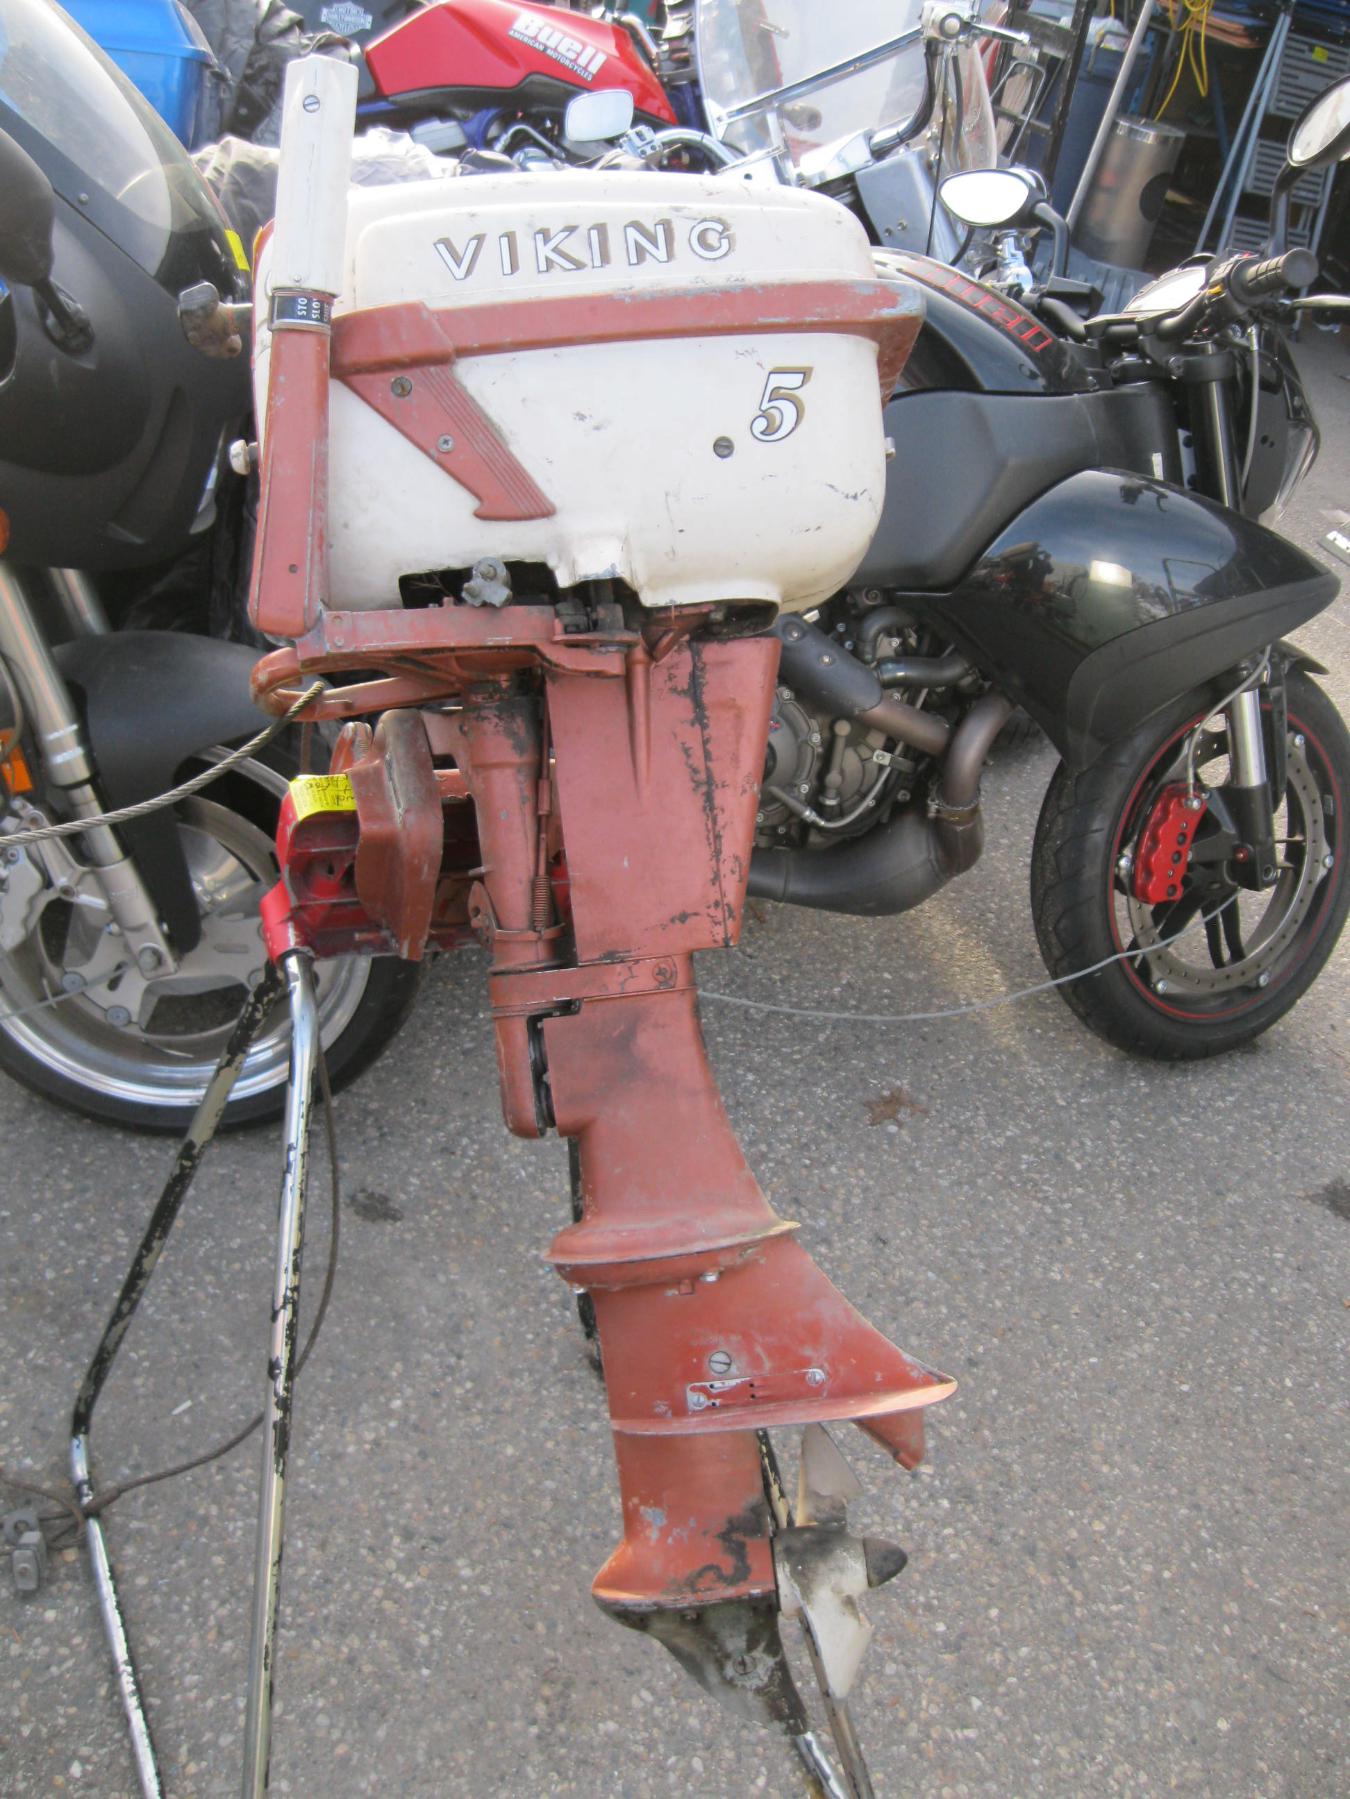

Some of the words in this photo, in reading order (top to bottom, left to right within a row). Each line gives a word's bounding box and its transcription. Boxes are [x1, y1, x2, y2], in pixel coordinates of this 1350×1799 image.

[508, 29, 545, 52] AMERICAN
[546, 48, 593, 82] MOTORCYCLES
[511, 12, 608, 75] Buell
[433, 217, 737, 281] VIKING
[312, 298, 321, 320] SLO
[750, 366, 814, 442] 5
